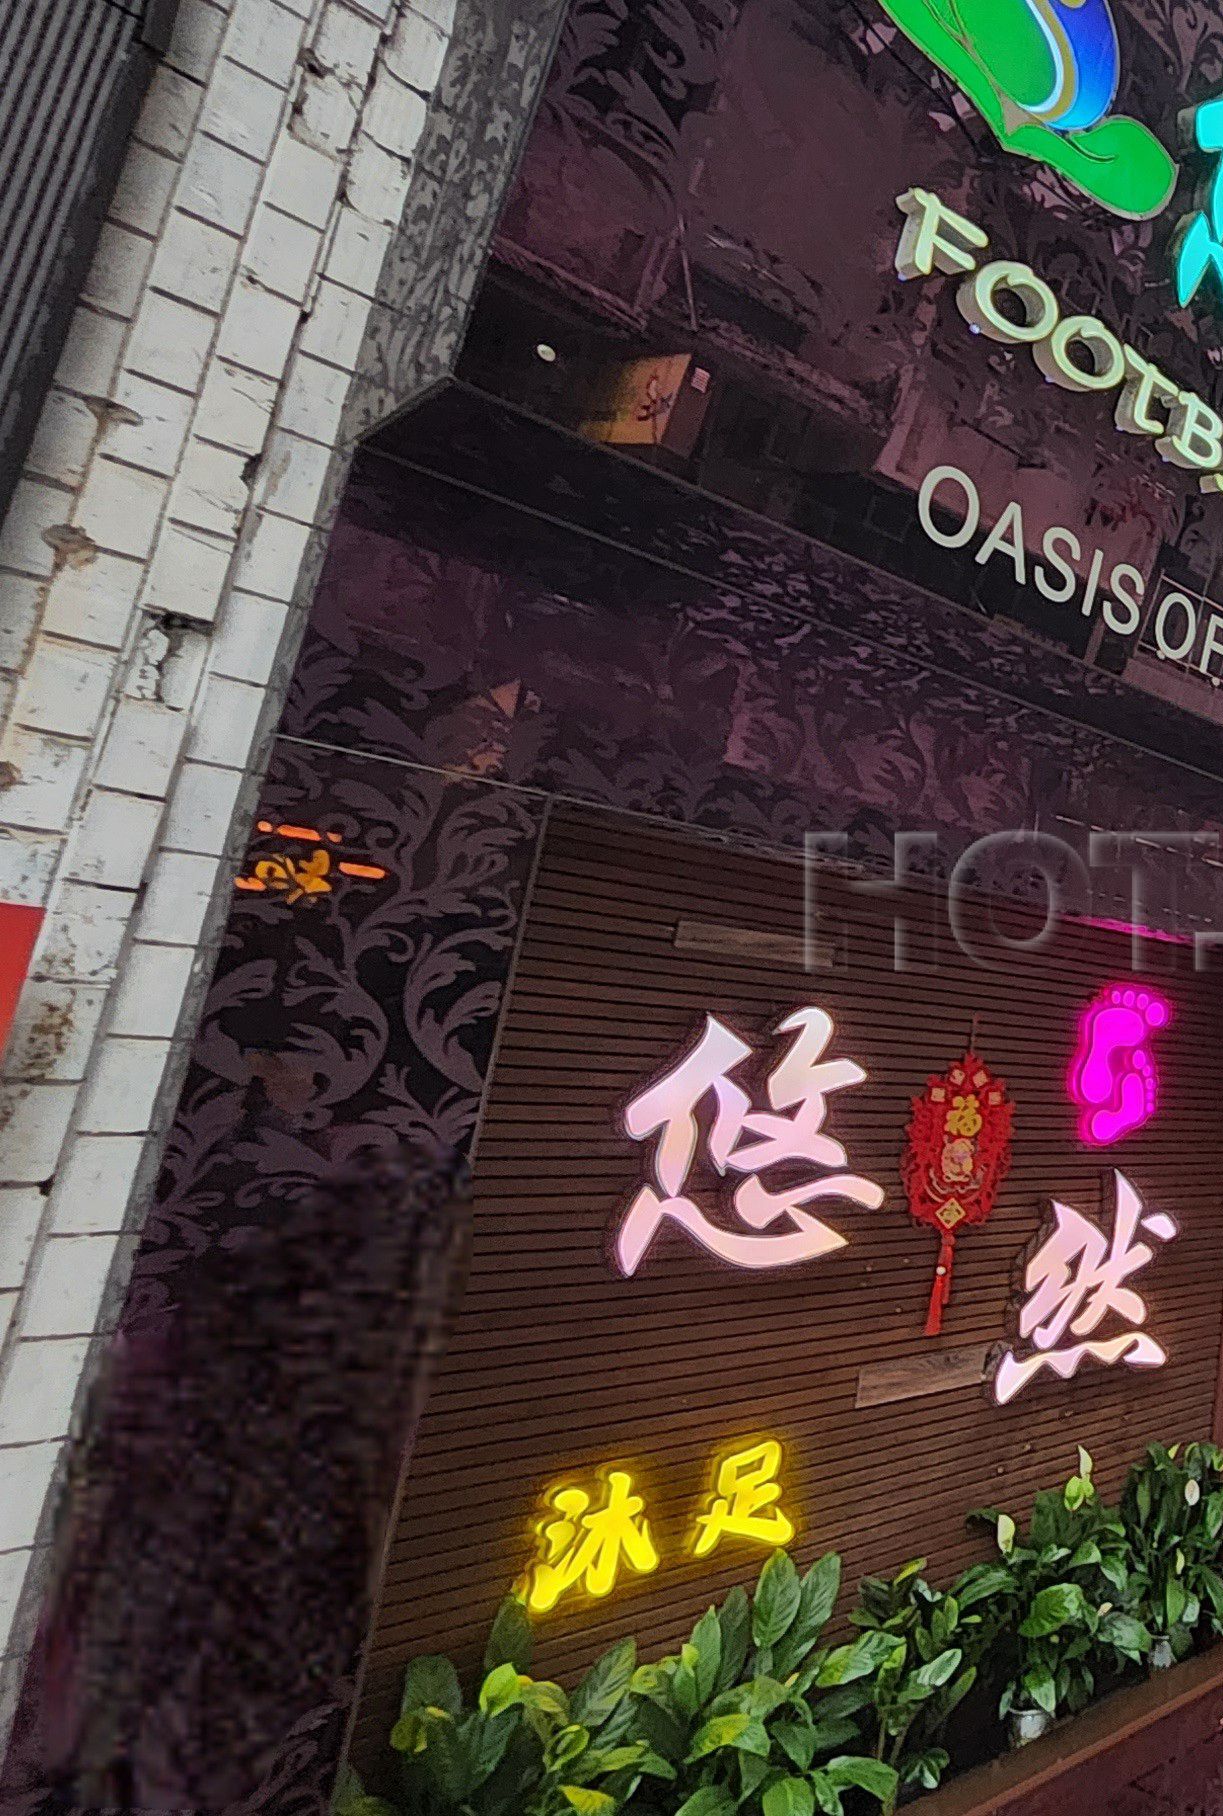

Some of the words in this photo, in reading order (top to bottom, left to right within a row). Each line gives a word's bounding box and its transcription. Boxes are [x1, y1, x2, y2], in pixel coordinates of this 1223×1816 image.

[918, 466, 1145, 636] OASIS
[944, 1093, 983, 1137] 福
[528, 1440, 796, 1613] 沐足
